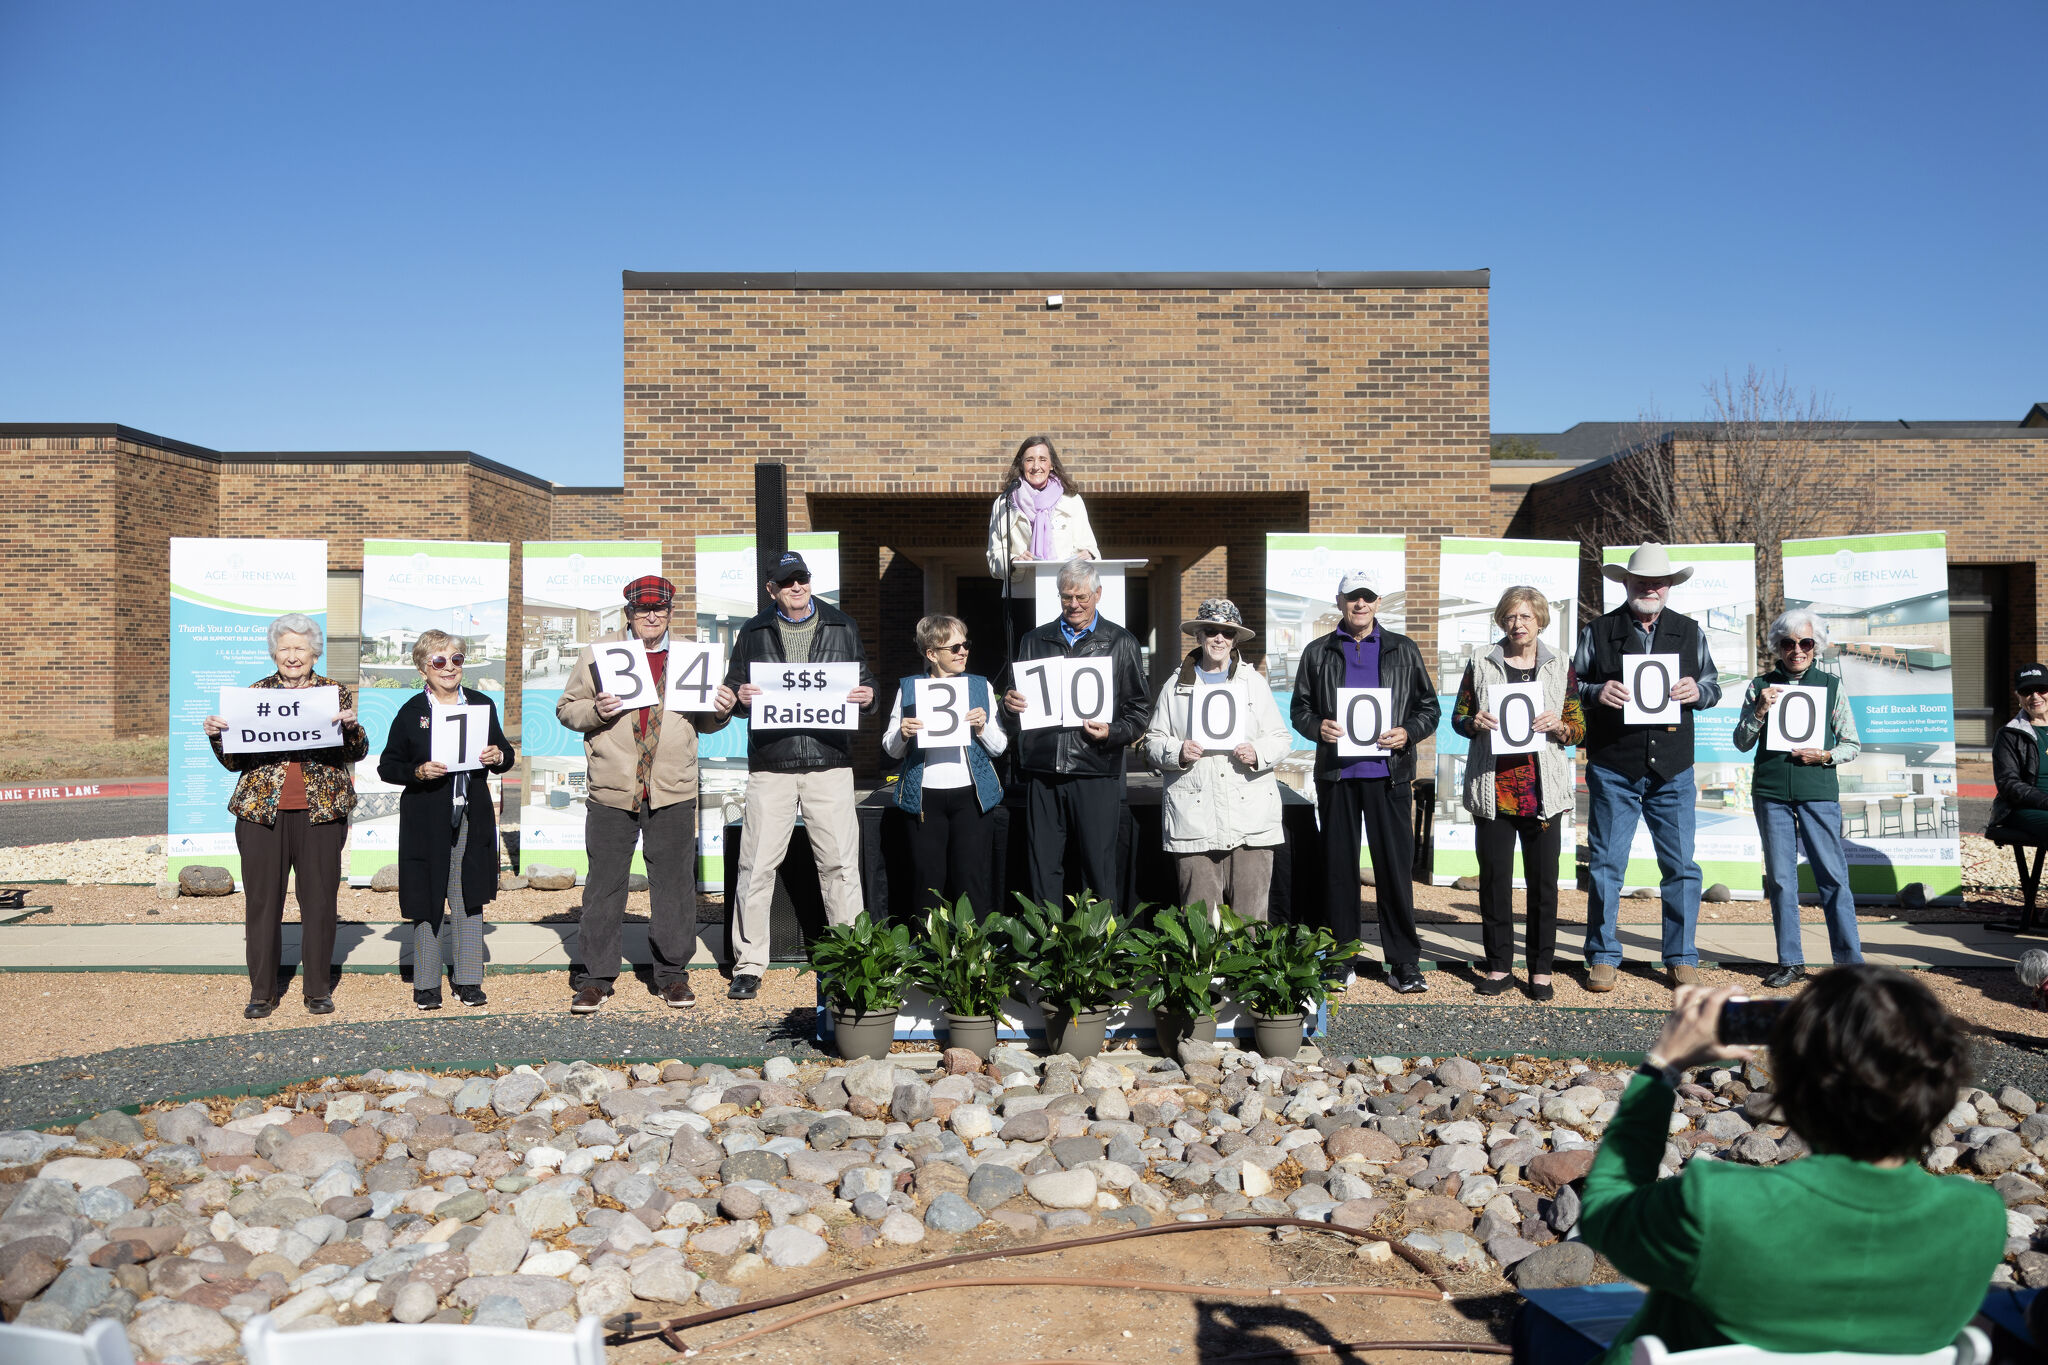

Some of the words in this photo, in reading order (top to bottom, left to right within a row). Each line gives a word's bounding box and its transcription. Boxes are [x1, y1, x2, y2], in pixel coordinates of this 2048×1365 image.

[204, 570, 227, 581] AGE
[242, 570, 297, 581] RENEWAL
[388, 573, 411, 584] AGE
[427, 574, 485, 586] RENEWAL
[546, 575, 568, 585] AGE
[583, 575, 635, 585] RENEWA
[720, 570, 743, 581] AGE
[1290, 568, 1313, 578] AGE
[1464, 572, 1486, 583] AGE
[1501, 574, 1556, 585] RENEWAL
[1811, 573, 1836, 584] AGE
[1853, 568, 1919, 581] RENEWAL
[178, 624, 206, 633] Thank
[207, 625, 223, 633] You
[224, 625, 233, 633] to
[234, 625, 249, 633] Our
[605, 648, 643, 701] 3
[675, 651, 713, 704] 4
[782, 669, 828, 692] $$$
[1025, 664, 1052, 717] 1
[1070, 667, 1105, 720] 0
[1633, 660, 1671, 715] 0
[256, 702, 272, 717] #
[277, 701, 300, 717] of
[763, 702, 846, 725] Raised
[927, 683, 959, 737] 3
[1201, 689, 1237, 740] 0
[1778, 691, 1816, 743] 0
[1866, 705, 1888, 714] Staff
[1890, 705, 1917, 713] Break
[1920, 704, 1947, 713] Room
[1346, 693, 1382, 747] 0
[1499, 692, 1536, 748] 0
[1694, 715, 1722, 723] ellness
[241, 729, 322, 743] Donors
[445, 713, 468, 764] 1
[28, 787, 60, 799] FIRE
[65, 784, 100, 797] LANE
